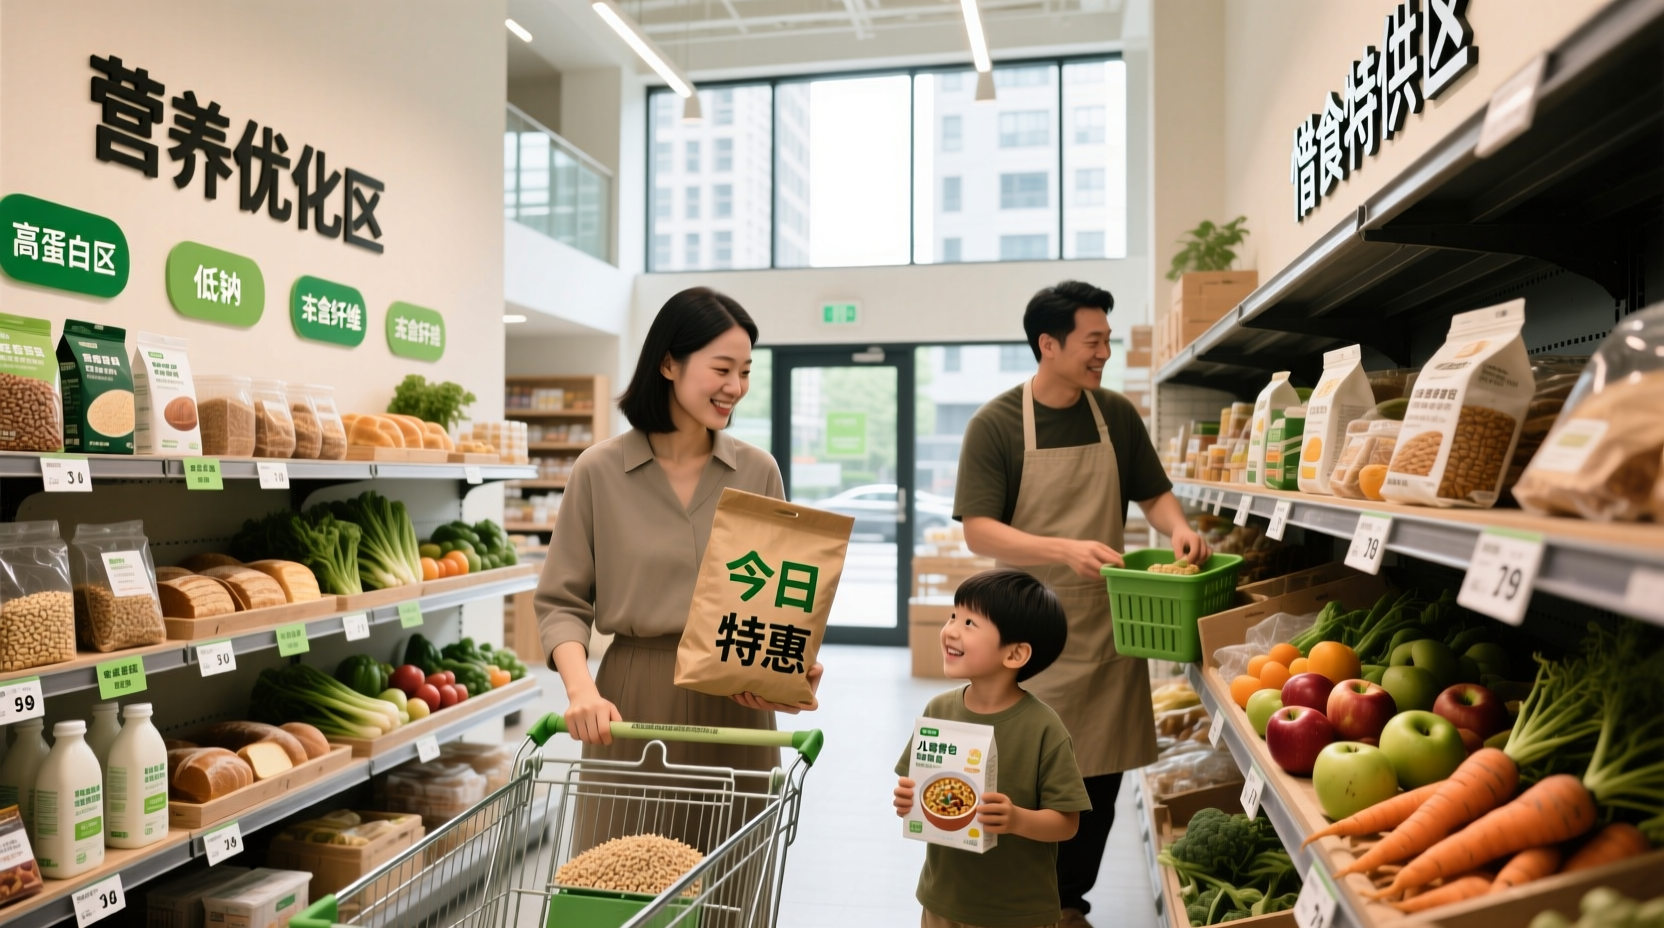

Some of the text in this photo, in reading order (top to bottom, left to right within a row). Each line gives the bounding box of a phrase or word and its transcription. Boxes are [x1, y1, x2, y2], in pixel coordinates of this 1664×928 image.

[1290, 0, 1475, 223] 惜食特供区
[89, 54, 385, 253] 营养优化区
[12, 221, 117, 276] 高蛋白区
[726, 550, 820, 613] 今日
[715, 611, 812, 674] 特惠
